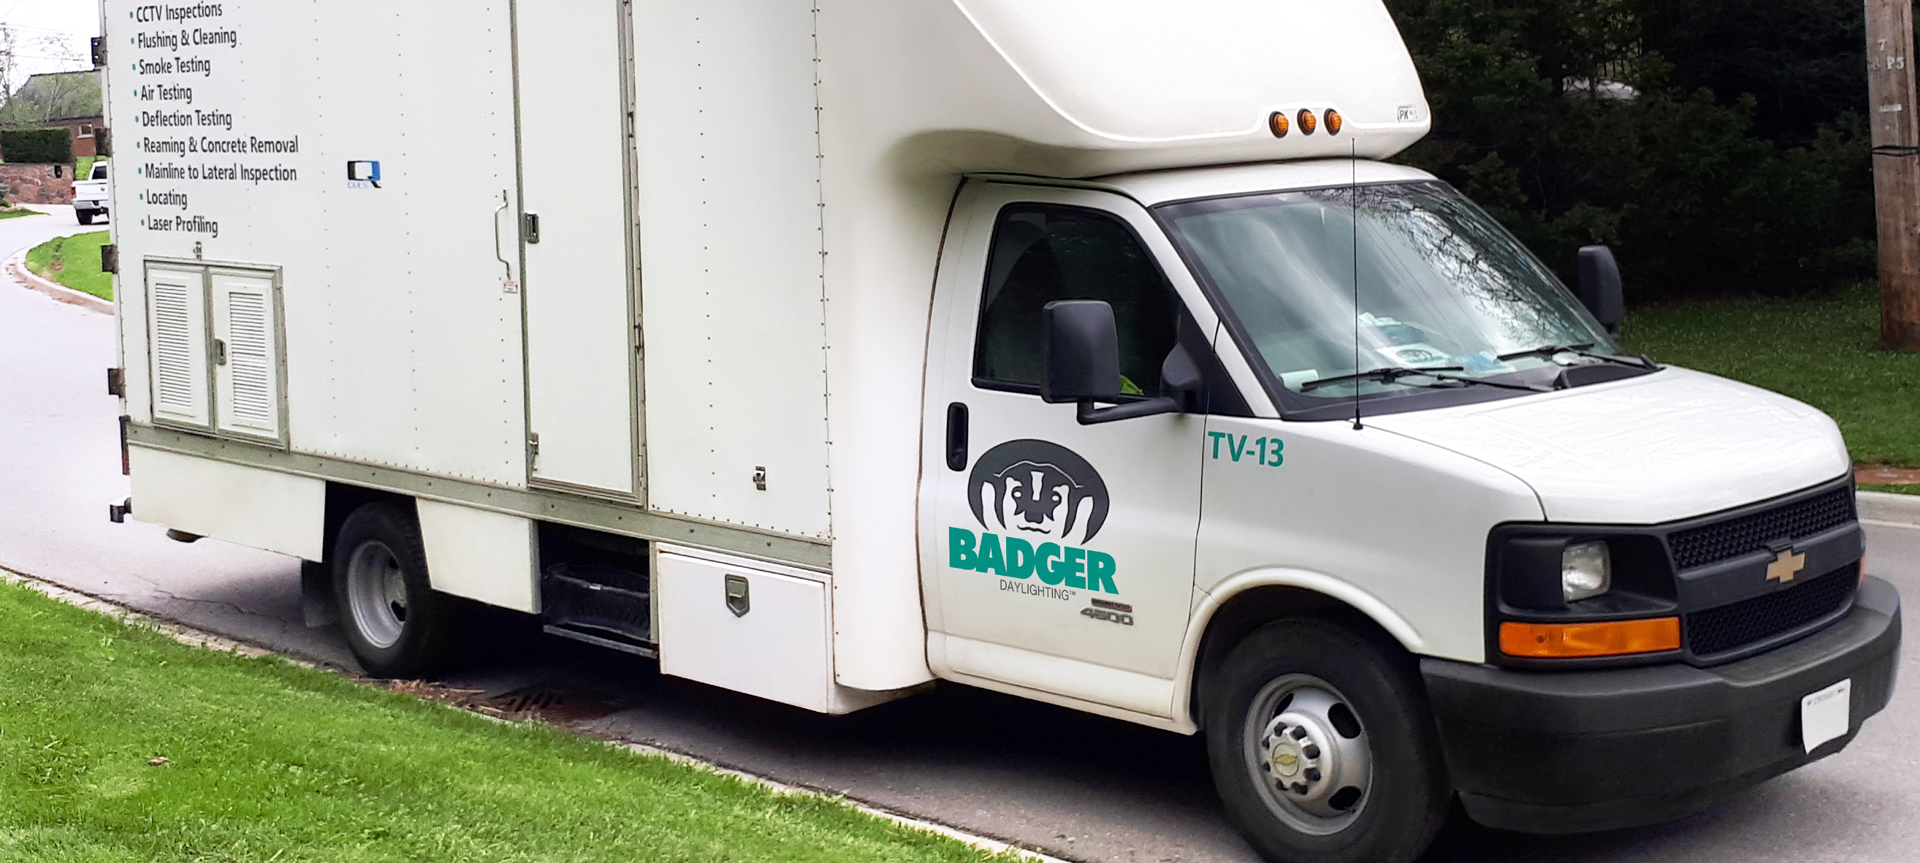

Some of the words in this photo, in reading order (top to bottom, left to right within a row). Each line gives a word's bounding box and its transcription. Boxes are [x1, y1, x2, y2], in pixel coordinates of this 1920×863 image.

[136, 5, 162, 23] CCTV
[165, 2, 223, 23] Inspections
[137, 31, 178, 52] Flushing
[180, 29, 190, 47] &
[192, 27, 237, 48] Cleaning
[139, 58, 173, 75] Smoke
[174, 56, 211, 77] Testing
[140, 84, 154, 101] Air
[157, 84, 193, 104] Testing
[142, 110, 193, 127] Deflection
[195, 109, 232, 130] Testing
[143, 137, 186, 156] Reaming
[188, 136, 198, 153] &
[200, 136, 247, 154] Concrete
[250, 135, 299, 153] Removal
[145, 162, 186, 180] Mainline
[187, 164, 199, 180] to
[201, 162, 237, 181] Lateral
[240, 163, 297, 186] Inspection
[146, 189, 188, 210] Locating
[147, 215, 173, 232] Laser
[175, 215, 219, 238] Profiling
[1208, 431, 1285, 468] TV-13
[948, 526, 1120, 595] BADGER
